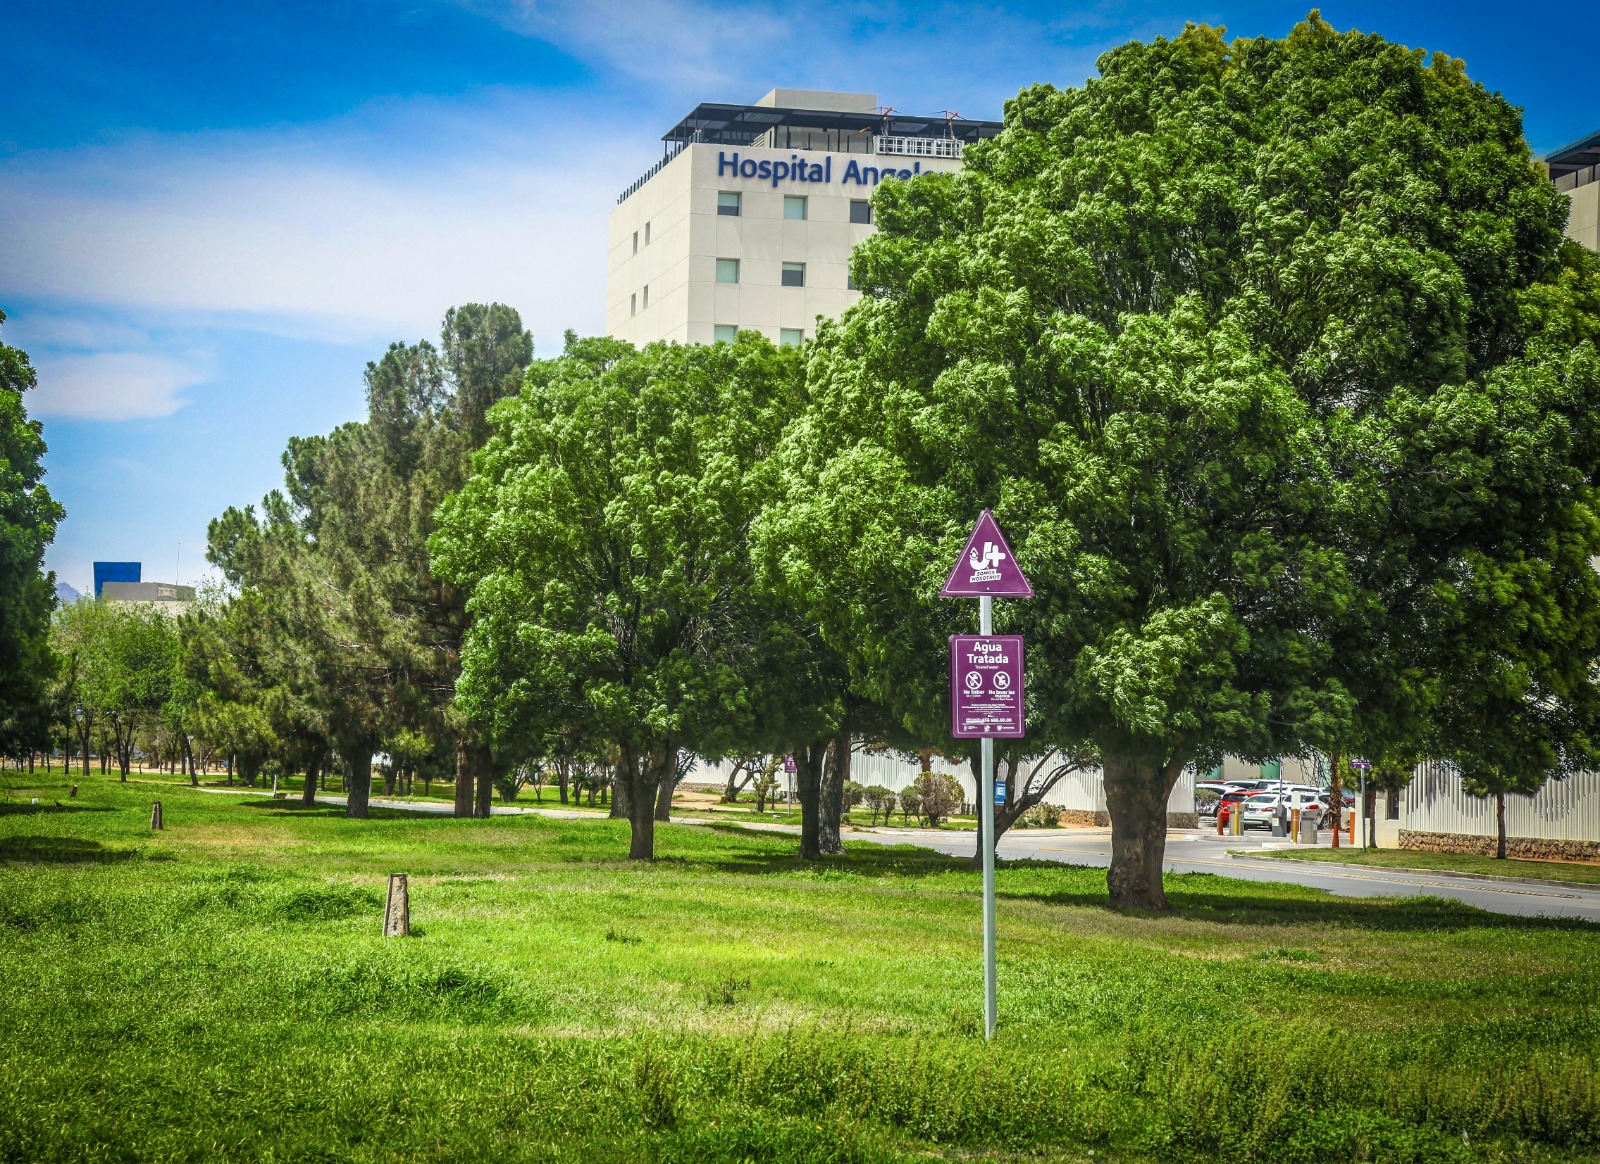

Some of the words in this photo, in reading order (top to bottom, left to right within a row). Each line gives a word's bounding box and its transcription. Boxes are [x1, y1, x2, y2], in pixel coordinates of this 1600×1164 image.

[717, 151, 831, 188] Hospital
[973, 641, 1002, 655] Agua
[966, 653, 1009, 664] Tratada
